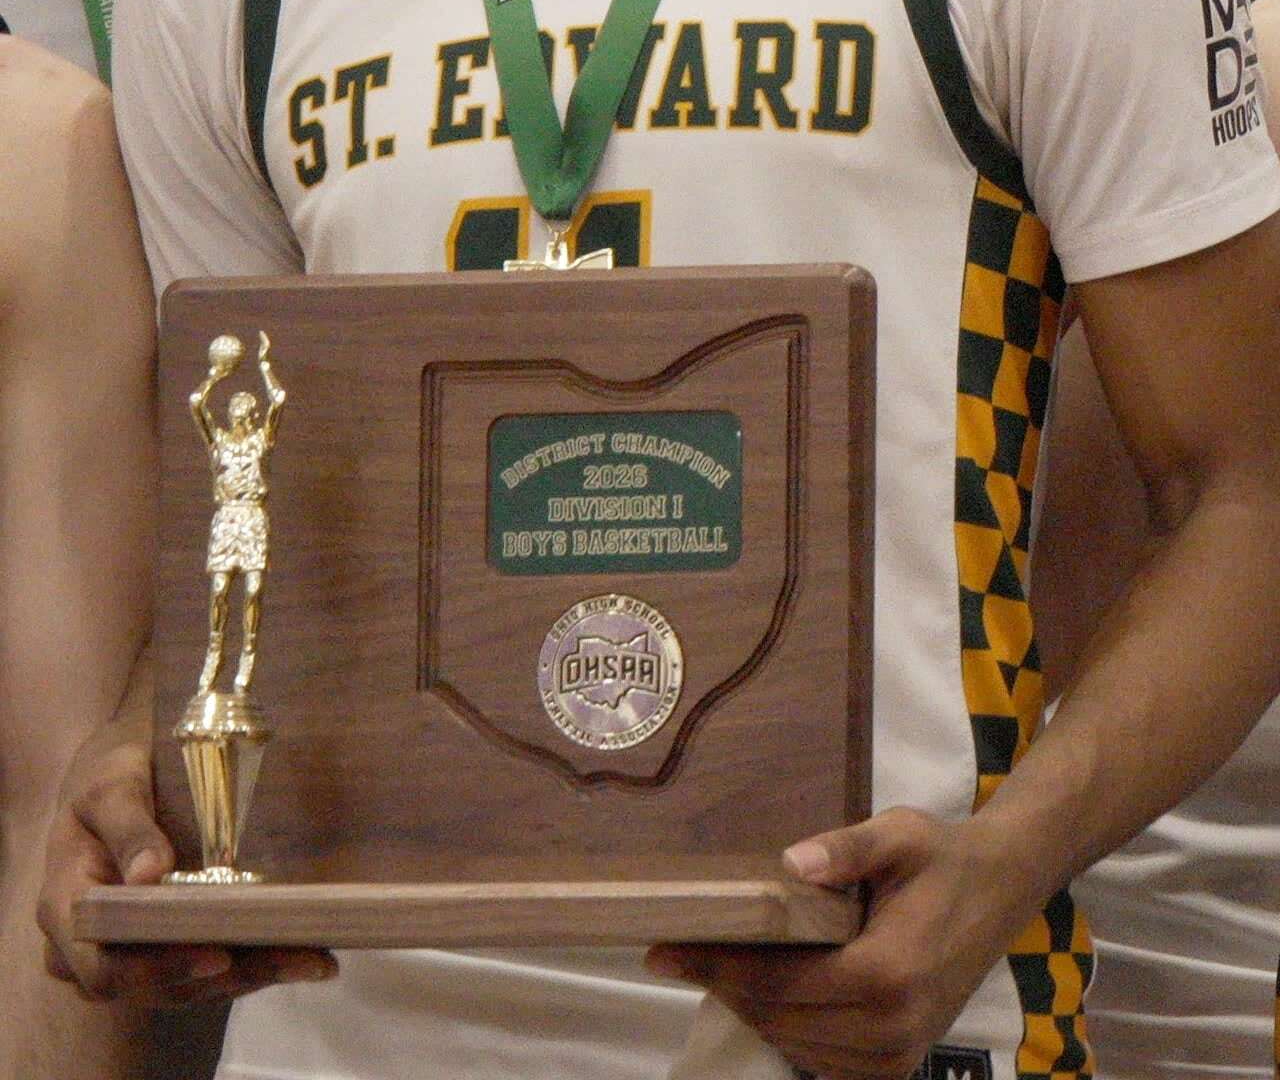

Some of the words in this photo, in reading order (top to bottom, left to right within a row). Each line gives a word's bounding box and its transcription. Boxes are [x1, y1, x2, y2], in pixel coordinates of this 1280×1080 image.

[288, 53, 396, 189] ST.
[1211, 95, 1261, 147] HOOPS
[501, 432, 606, 490] DISTRICT
[611, 432, 733, 491] CHAMPION
[583, 464, 649, 490] 2026
[547, 495, 667, 523] DIVISION
[672, 494, 684, 520] I
[502, 530, 568, 558] BOYS
[572, 525, 729, 557] BASKETBALL
[623, 598, 671, 641] SCHOOL
[566, 654, 655, 685] OHSAA
